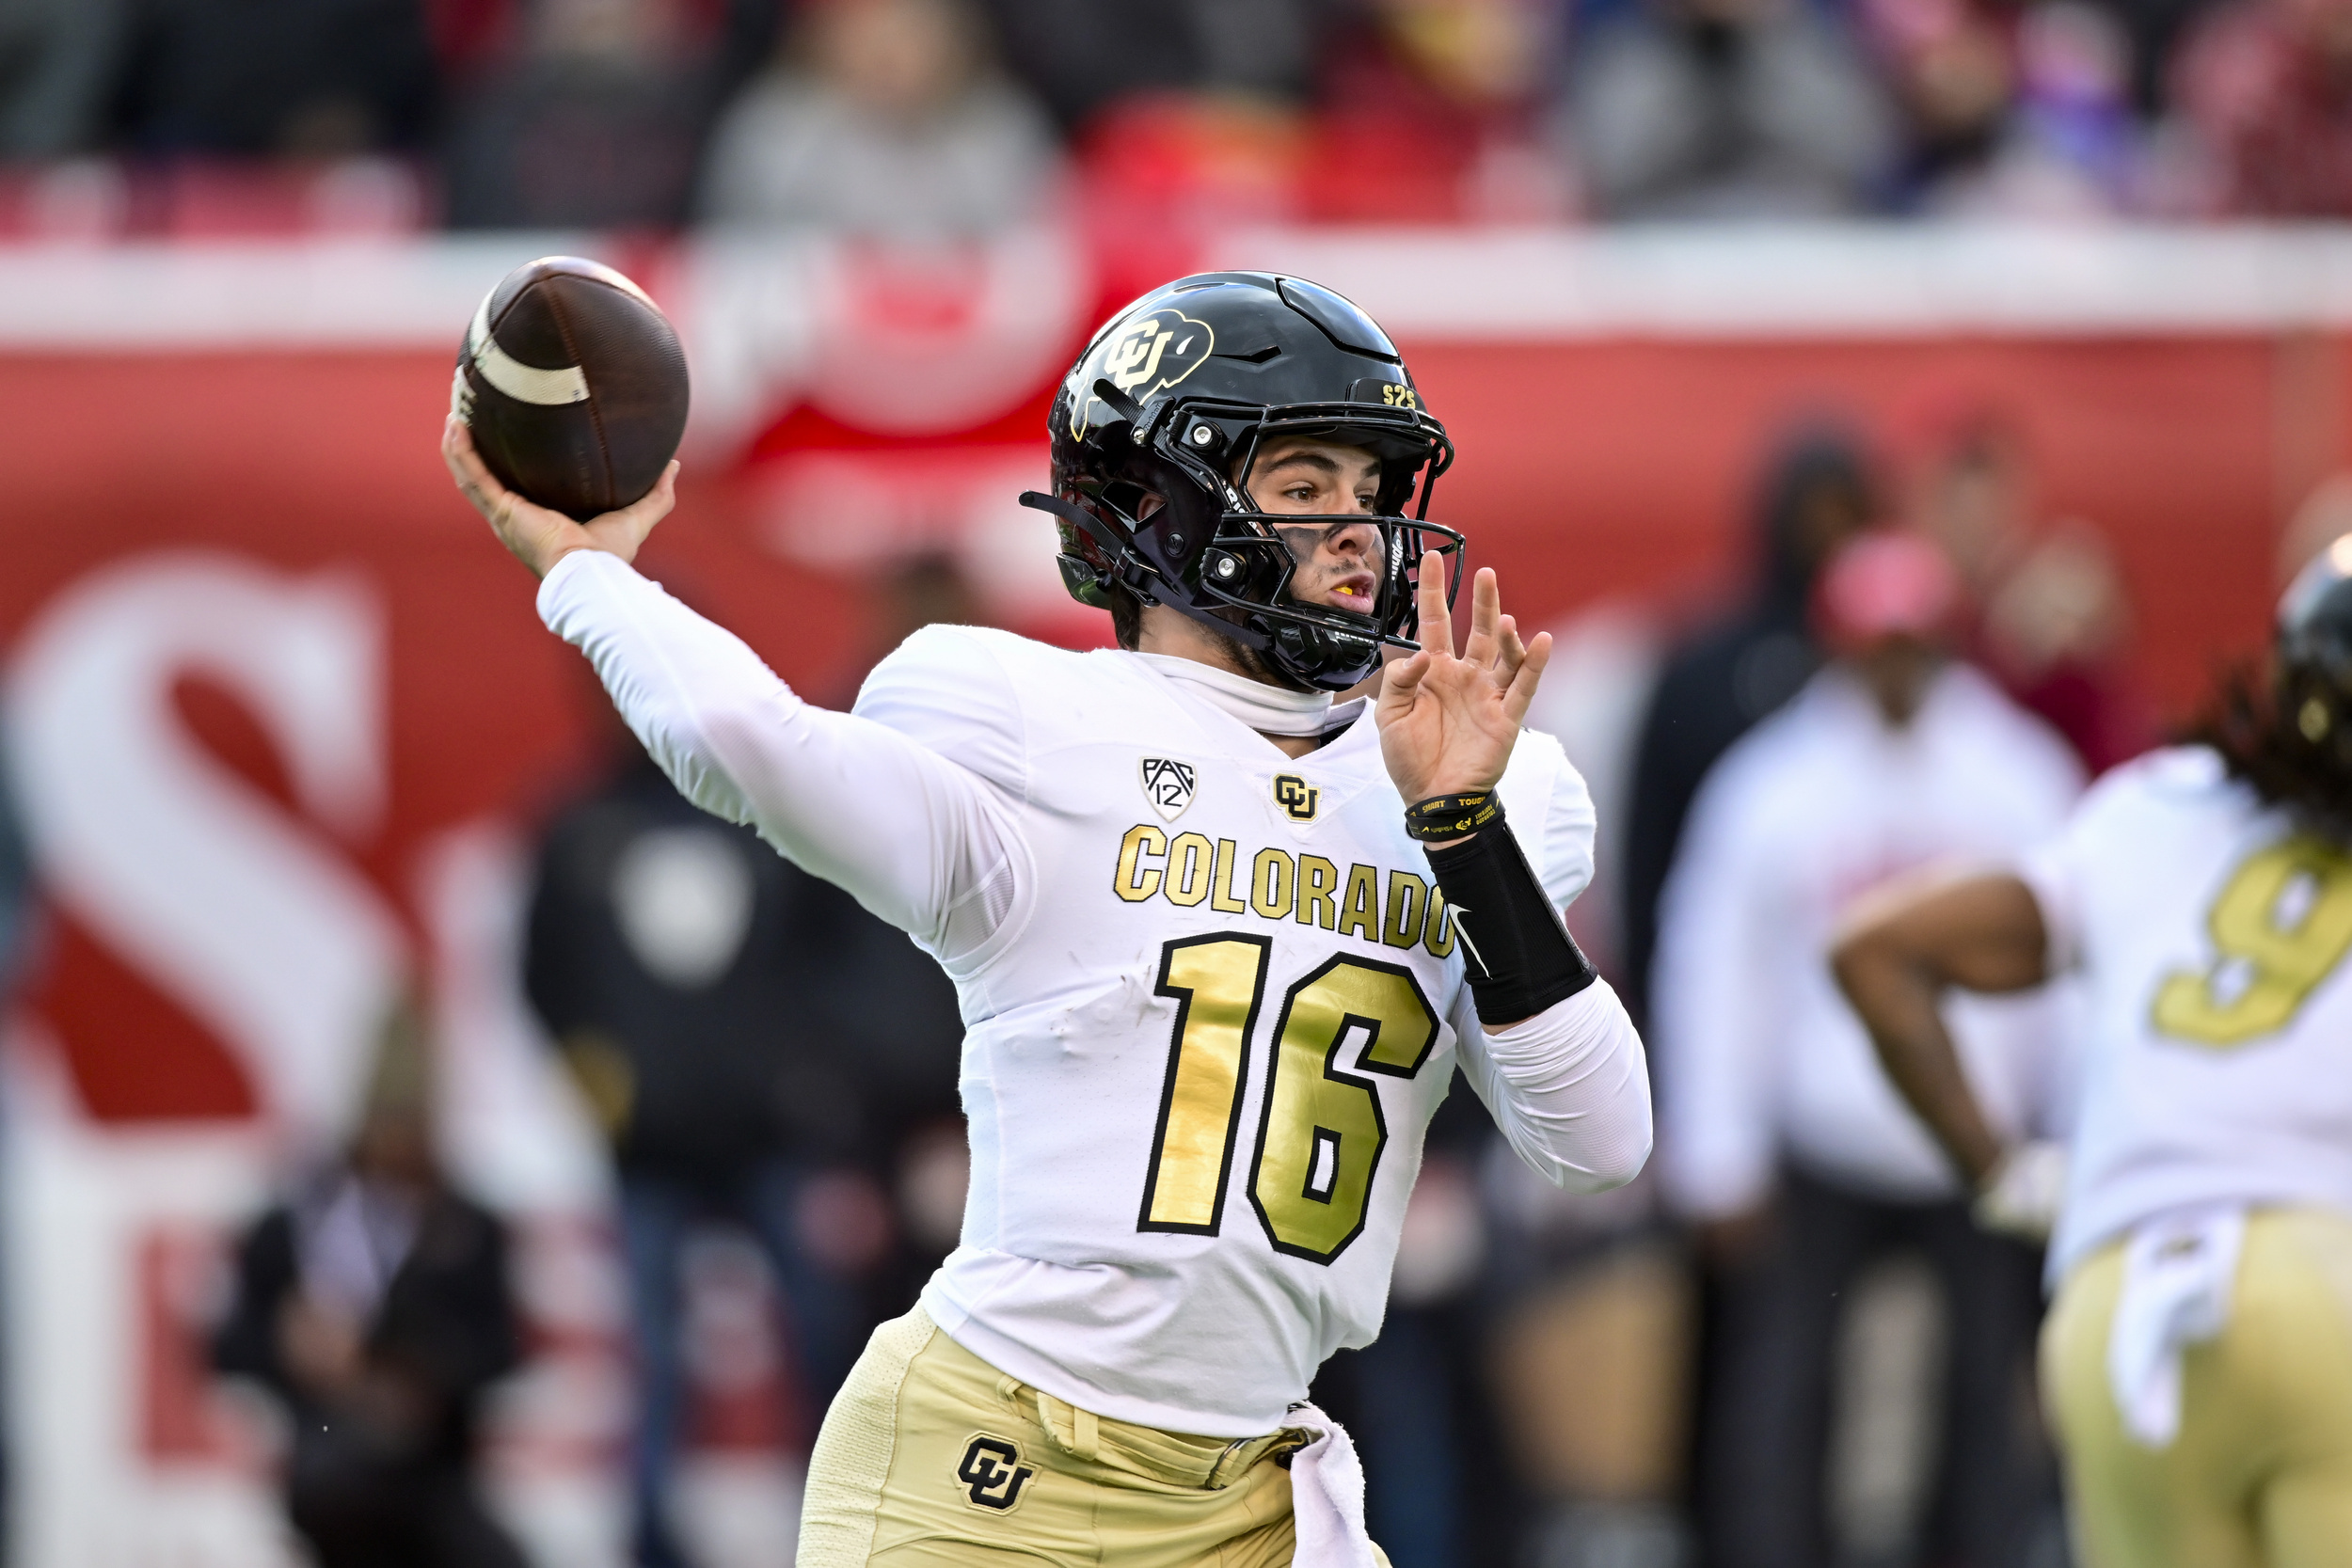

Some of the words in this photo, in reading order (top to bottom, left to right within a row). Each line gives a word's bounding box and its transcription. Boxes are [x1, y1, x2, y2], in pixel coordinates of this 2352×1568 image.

[1104, 319, 1174, 389] CU
[1142, 758, 1196, 800] PAC
[1154, 784, 1184, 808] 12
[1275, 774, 1319, 821] CU
[1422, 800, 1446, 814] SMART
[1113, 823, 1456, 958] COLORADO
[1136, 930, 1441, 1267] 16
[956, 1435, 1033, 1511] CU
